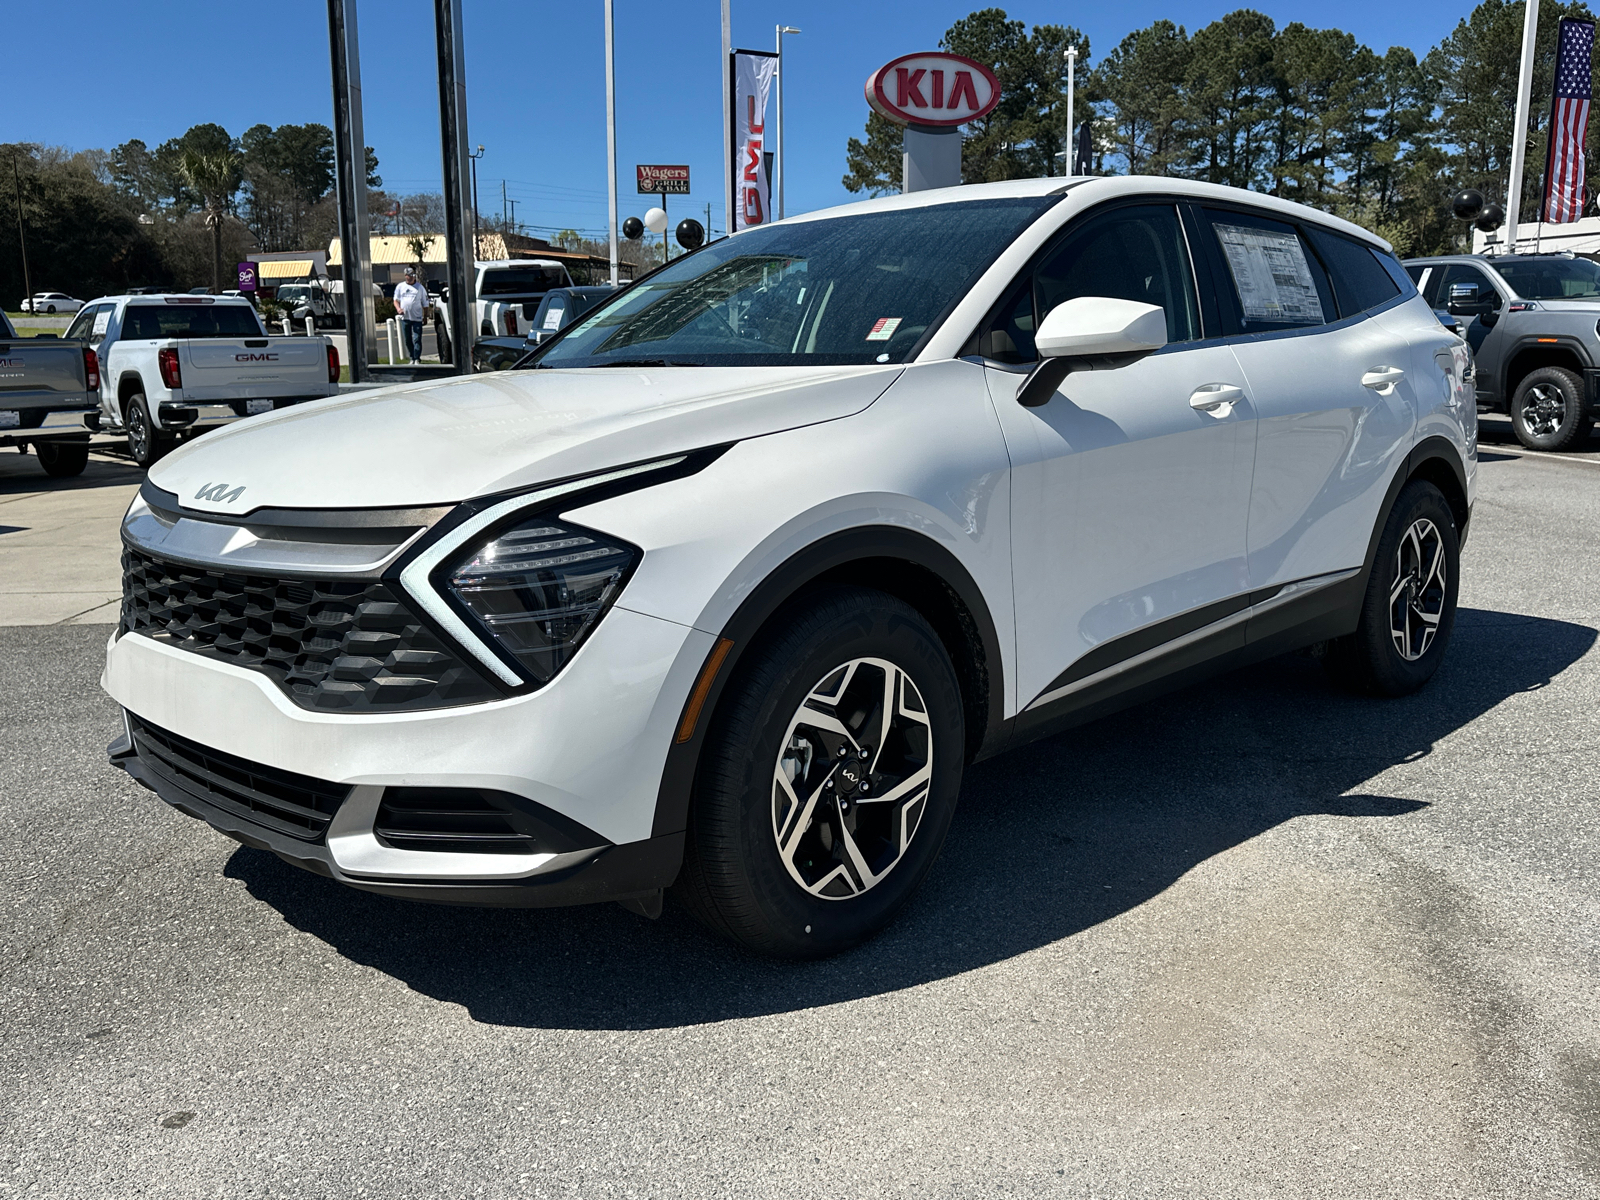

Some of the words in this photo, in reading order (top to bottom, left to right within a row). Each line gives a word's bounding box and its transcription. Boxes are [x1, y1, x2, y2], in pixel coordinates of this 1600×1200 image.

[895, 68, 980, 110] KIA
[742, 95, 764, 225] GMC
[639, 166, 687, 179] Wagers
[0, 358, 25, 368] MC
[235, 353, 279, 362] GMC
